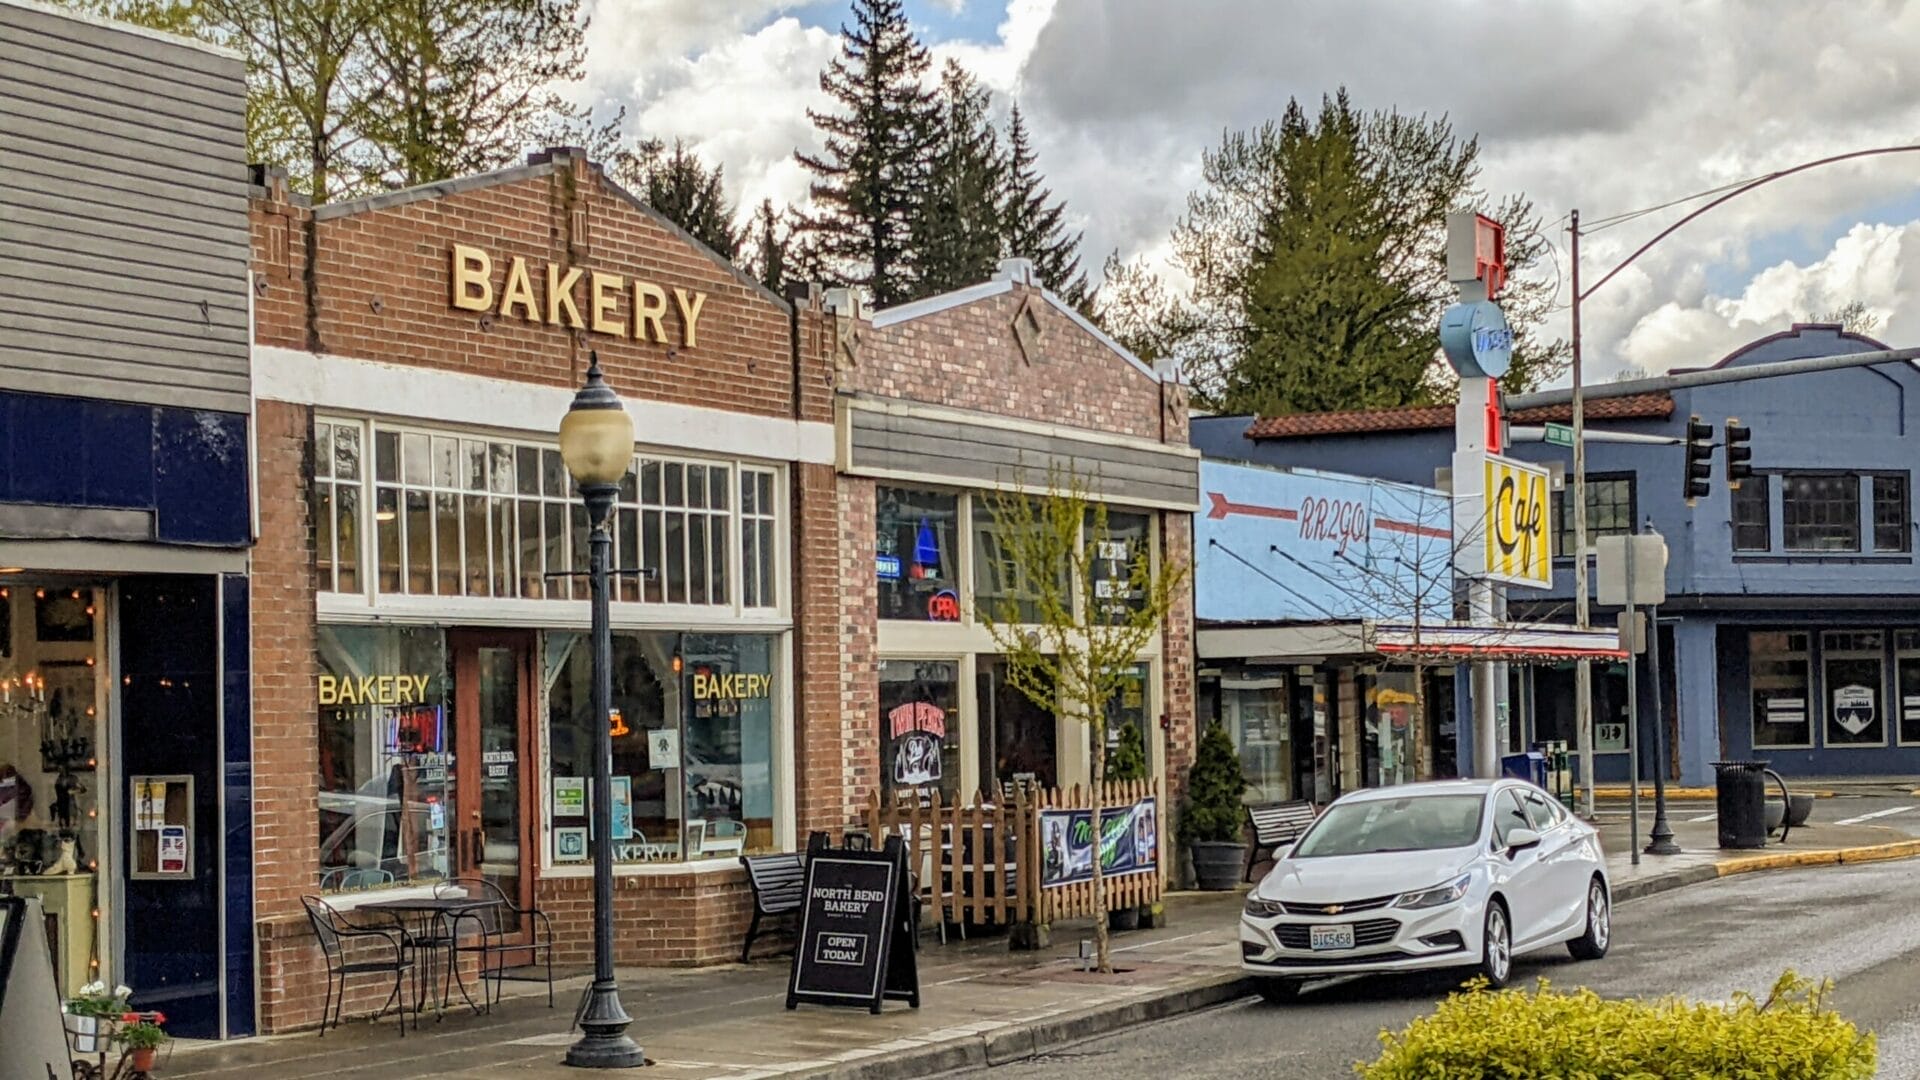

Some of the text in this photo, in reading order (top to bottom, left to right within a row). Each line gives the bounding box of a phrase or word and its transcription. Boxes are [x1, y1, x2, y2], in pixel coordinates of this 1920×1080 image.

[453, 243, 707, 348] BAKERY
[1495, 475, 1541, 576] Cafe
[318, 674, 430, 705] BAKERY
[693, 673, 772, 699] BAKERY
[888, 701, 945, 740] TWIN PEAKS
[609, 844, 666, 862] AKERY
[813, 888, 884, 902] NORTH BEND
[824, 902, 869, 913] BAKERY
[828, 937, 856, 948] OPEN
[823, 950, 858, 961] TODAY
